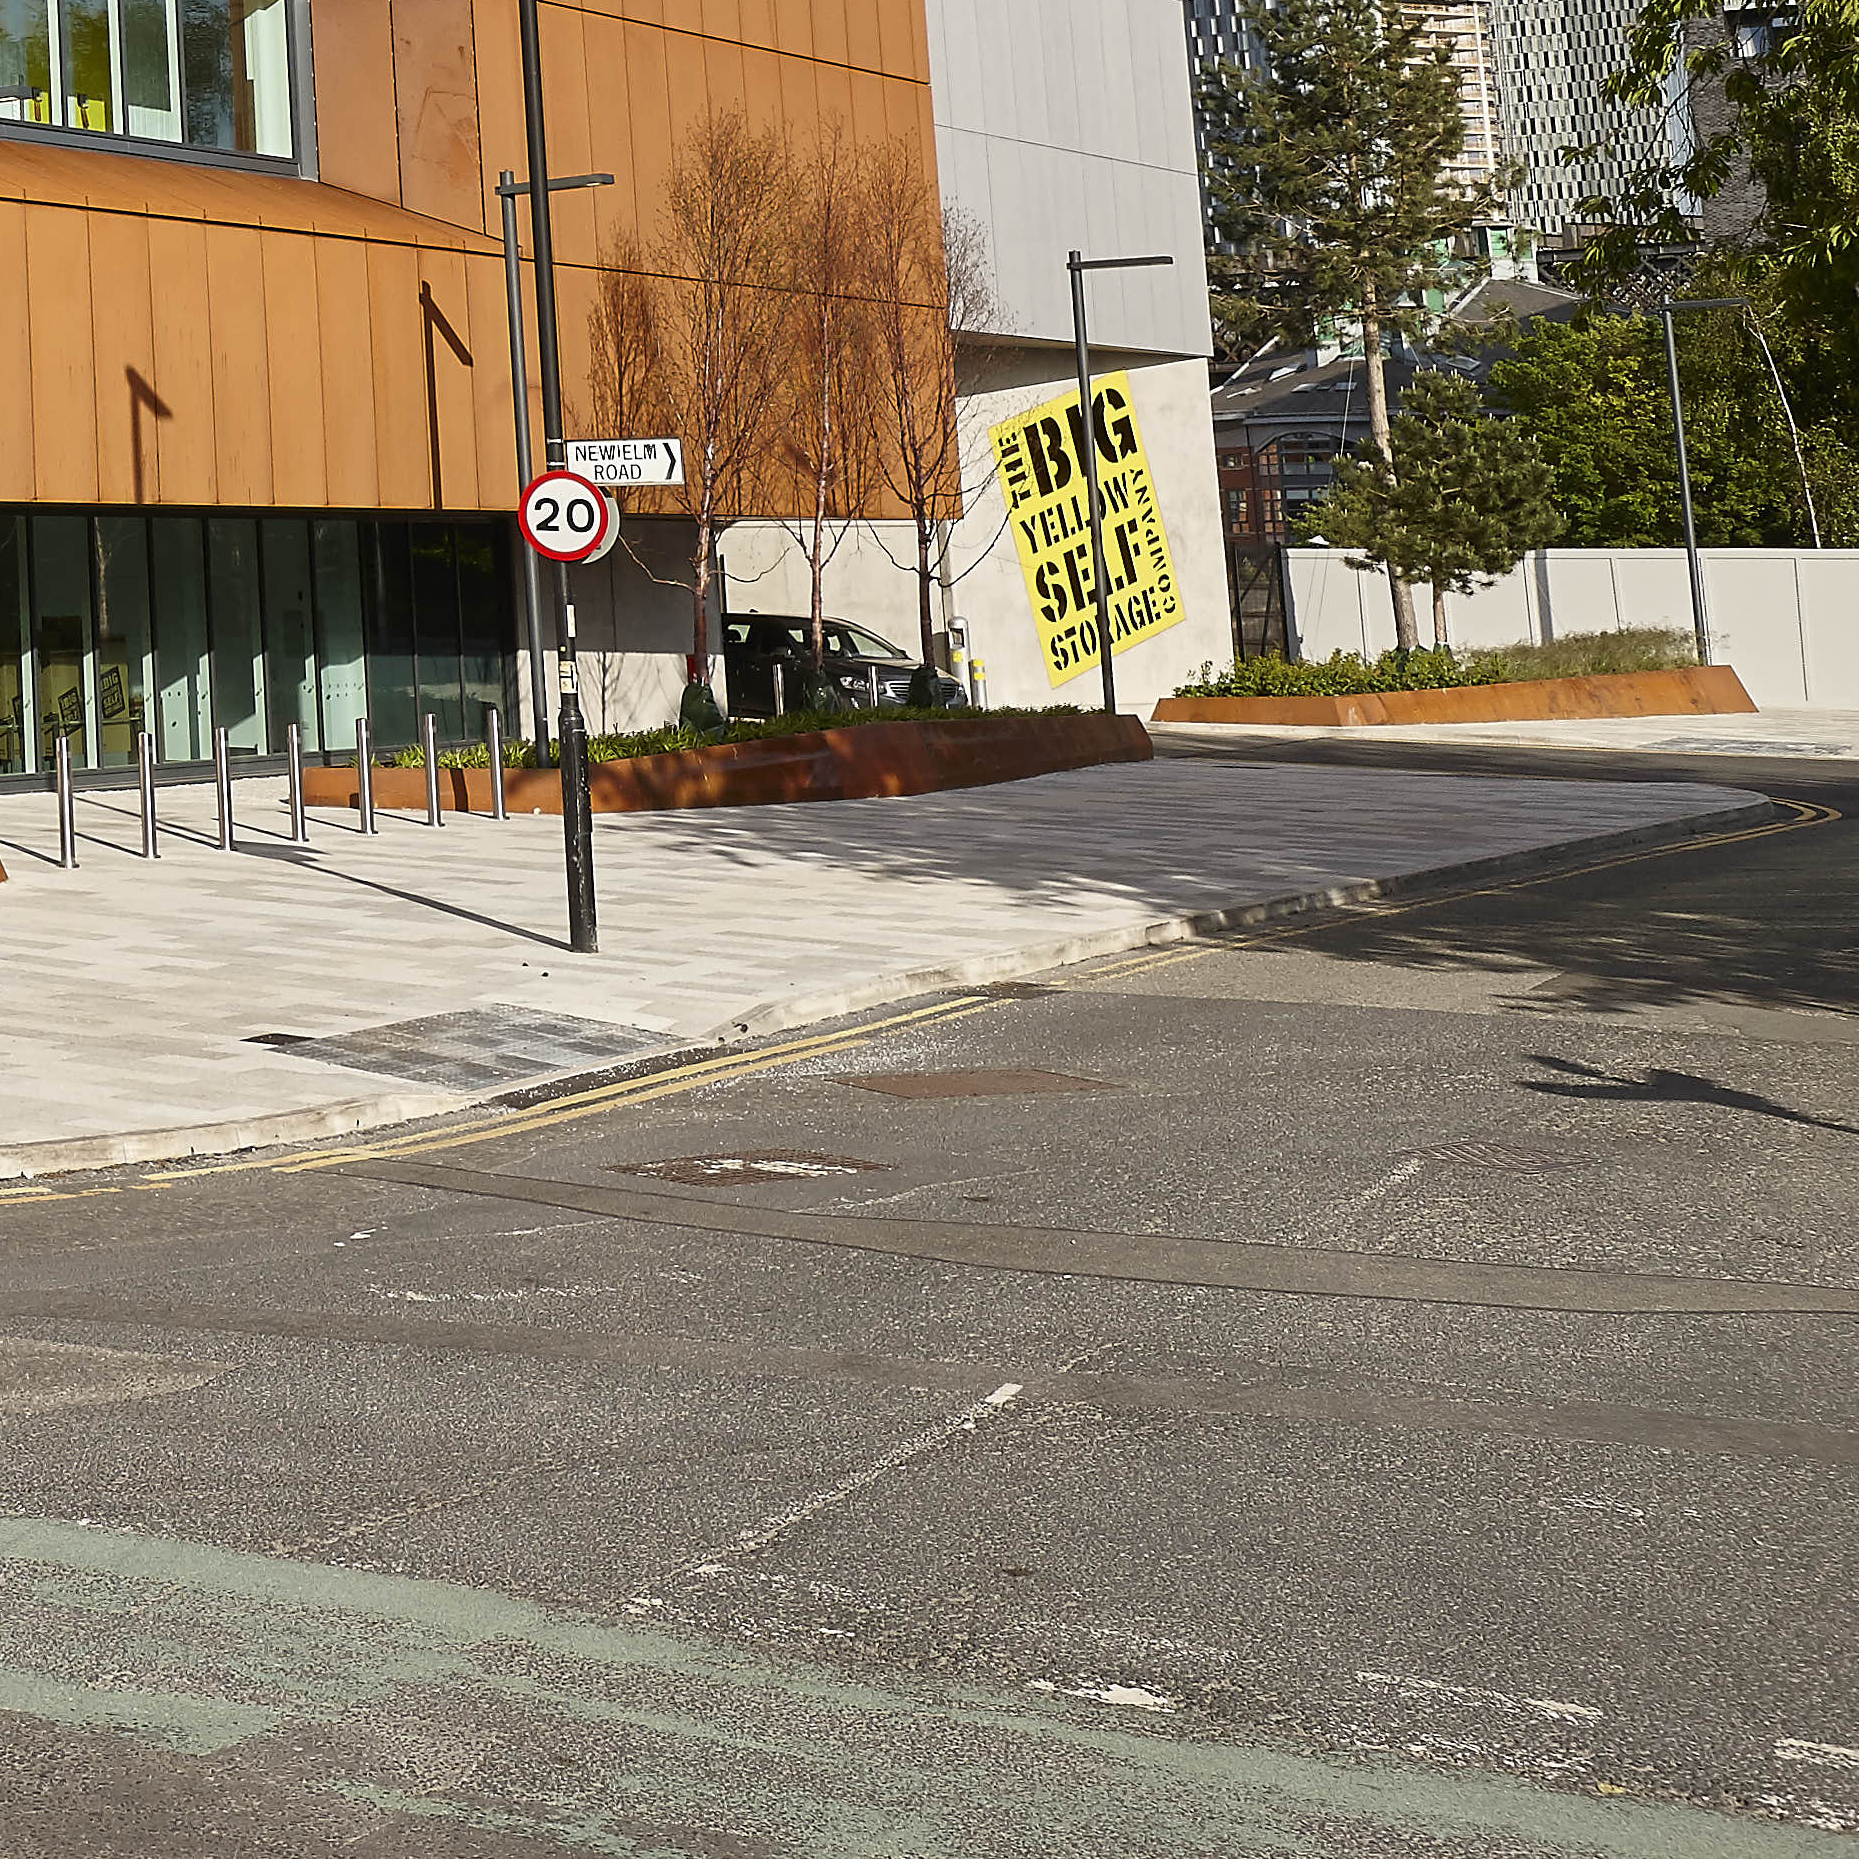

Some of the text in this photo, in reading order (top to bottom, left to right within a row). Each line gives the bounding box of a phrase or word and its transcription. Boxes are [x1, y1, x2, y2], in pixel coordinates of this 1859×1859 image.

[594, 464, 642, 480] ROAD
[997, 431, 1031, 510] THE
[1023, 387, 1139, 498] BIG
[534, 497, 595, 533] 20
[1128, 467, 1176, 614] COMPANY
[1035, 517, 1141, 623] SEF
[1050, 586, 1161, 671] STOAGE
